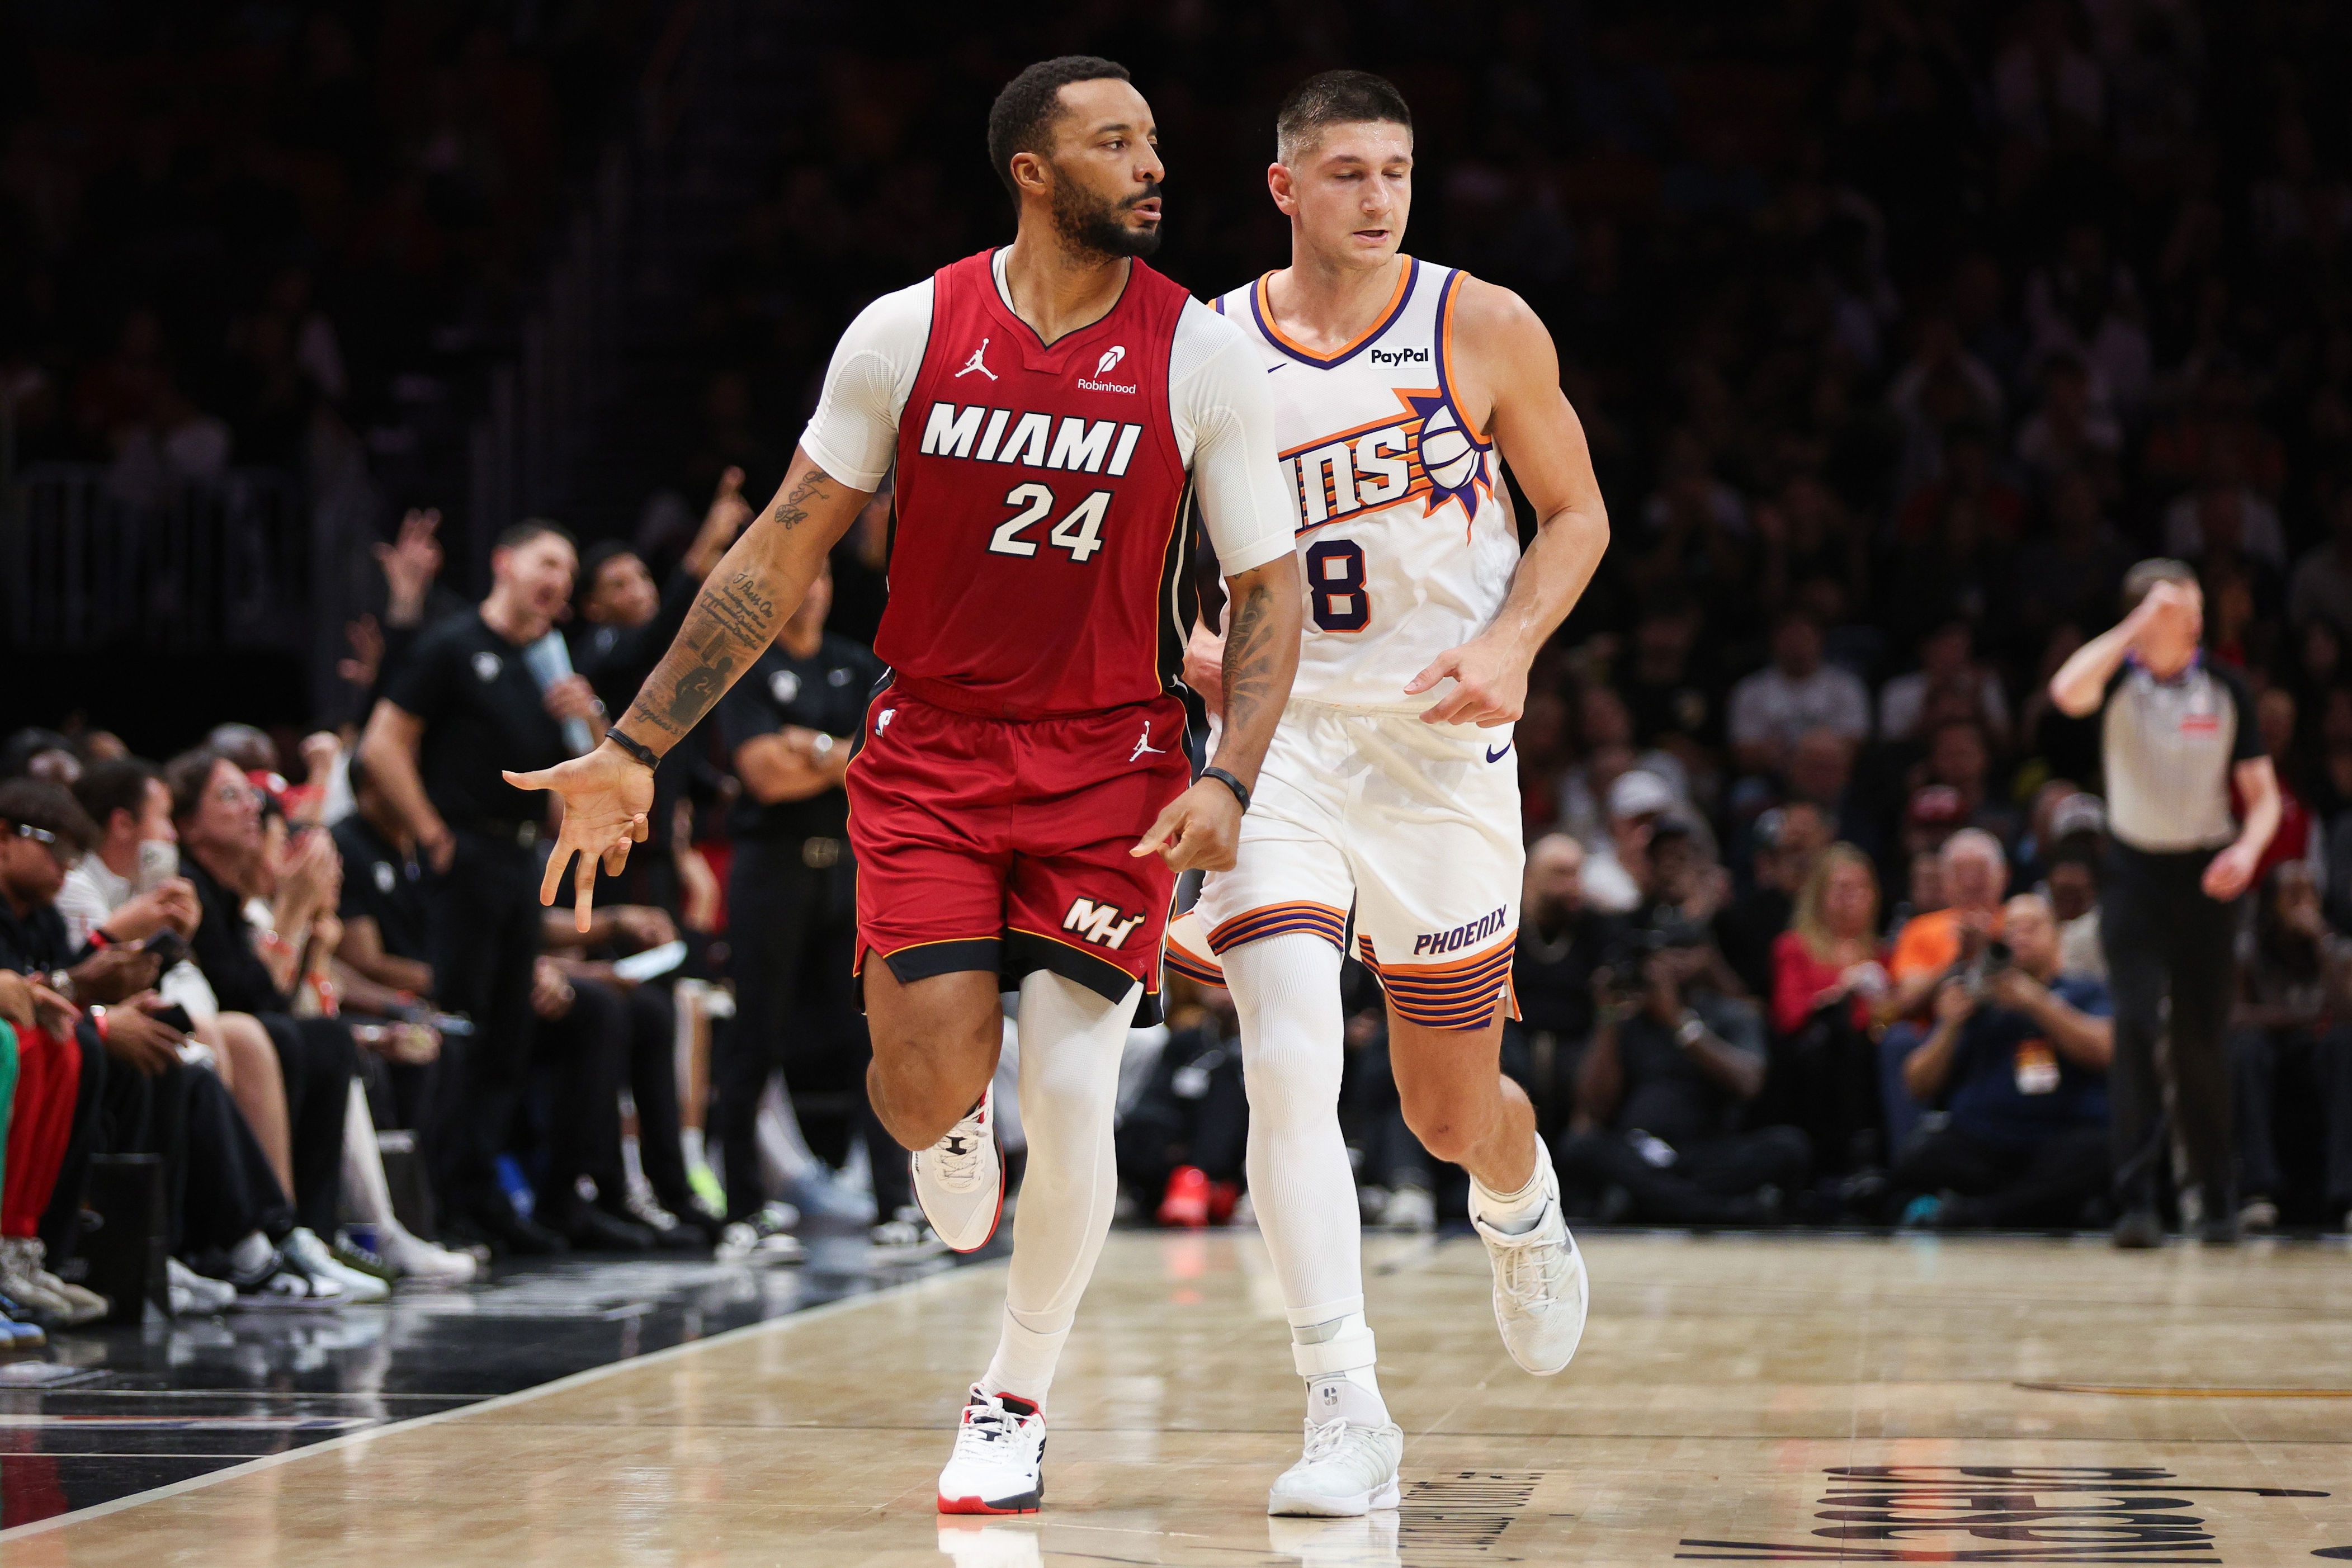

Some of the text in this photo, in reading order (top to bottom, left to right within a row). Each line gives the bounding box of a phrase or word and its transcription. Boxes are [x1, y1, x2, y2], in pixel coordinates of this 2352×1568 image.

[1078, 378, 1136, 395] Robinhood
[1371, 348, 1429, 367] PayPal
[919, 400, 1144, 479] MIAMI
[985, 479, 1115, 564] 24
[1306, 539, 1371, 634] 8
[1413, 903, 1508, 956] PHOENIX
[1674, 1465, 2331, 1564] Kaseya
